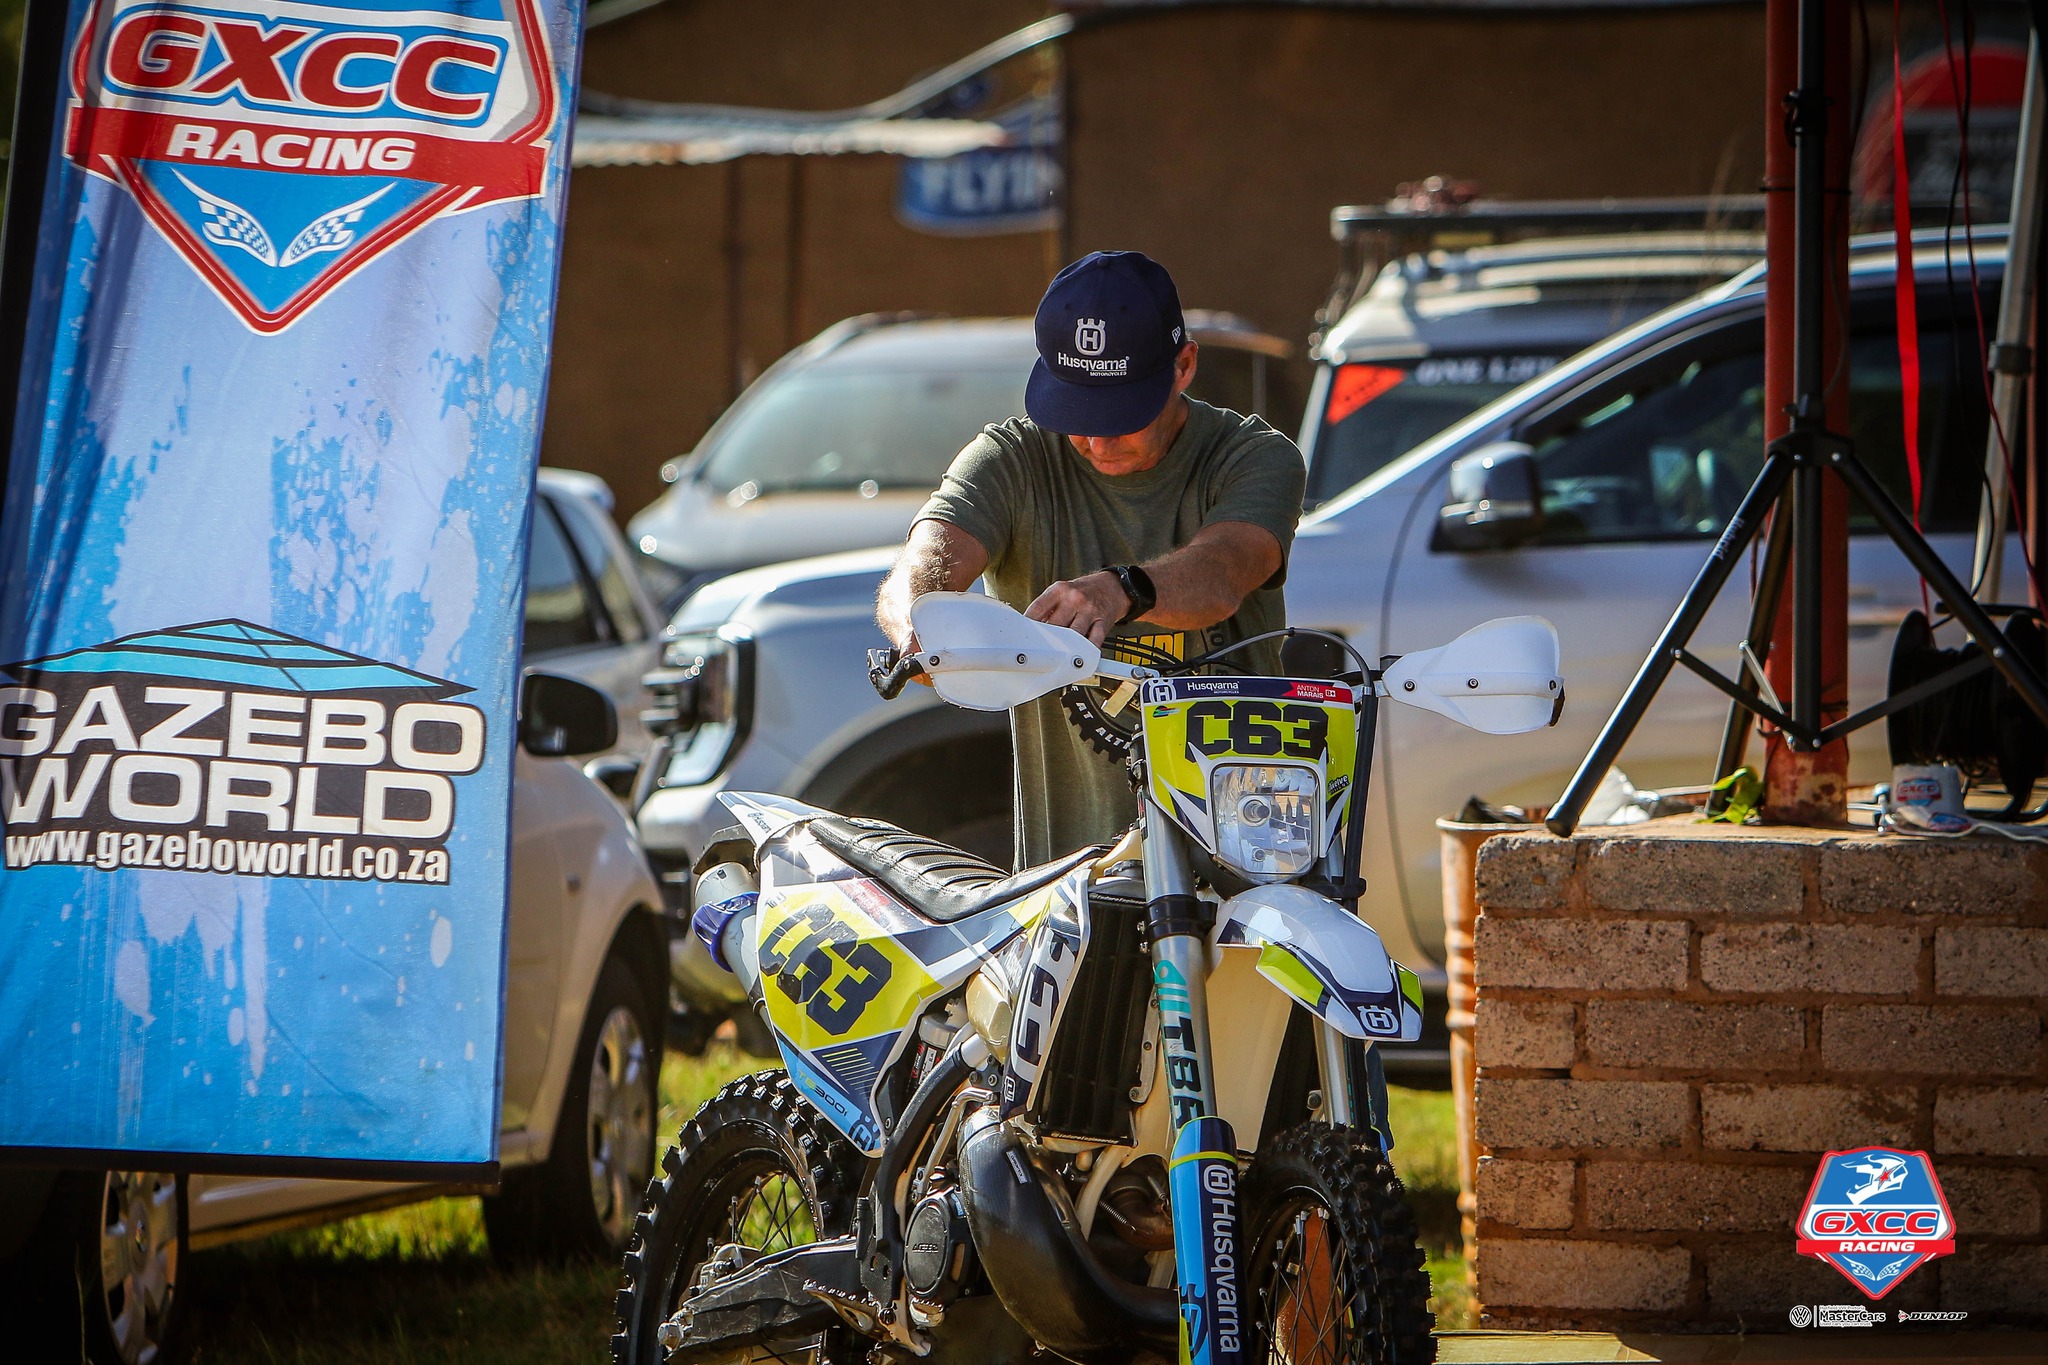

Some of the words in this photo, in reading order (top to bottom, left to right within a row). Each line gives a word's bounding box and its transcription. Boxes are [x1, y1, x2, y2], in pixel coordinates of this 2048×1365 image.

[107, 15, 500, 116] GXCC
[166, 123, 416, 171] RACING
[1057, 352, 1127, 371] Husqvarna
[1187, 681, 1239, 692] Husqvarna
[1297, 690, 1324, 698] MARAIS
[0, 685, 485, 775] GAZEBO
[1185, 701, 1330, 765] C63
[0, 753, 455, 839] WORLD
[6, 829, 450, 883] www.gazeboworld.co.za
[758, 903, 893, 1036] C63
[1210, 1198, 1241, 1353] Husqvarna
